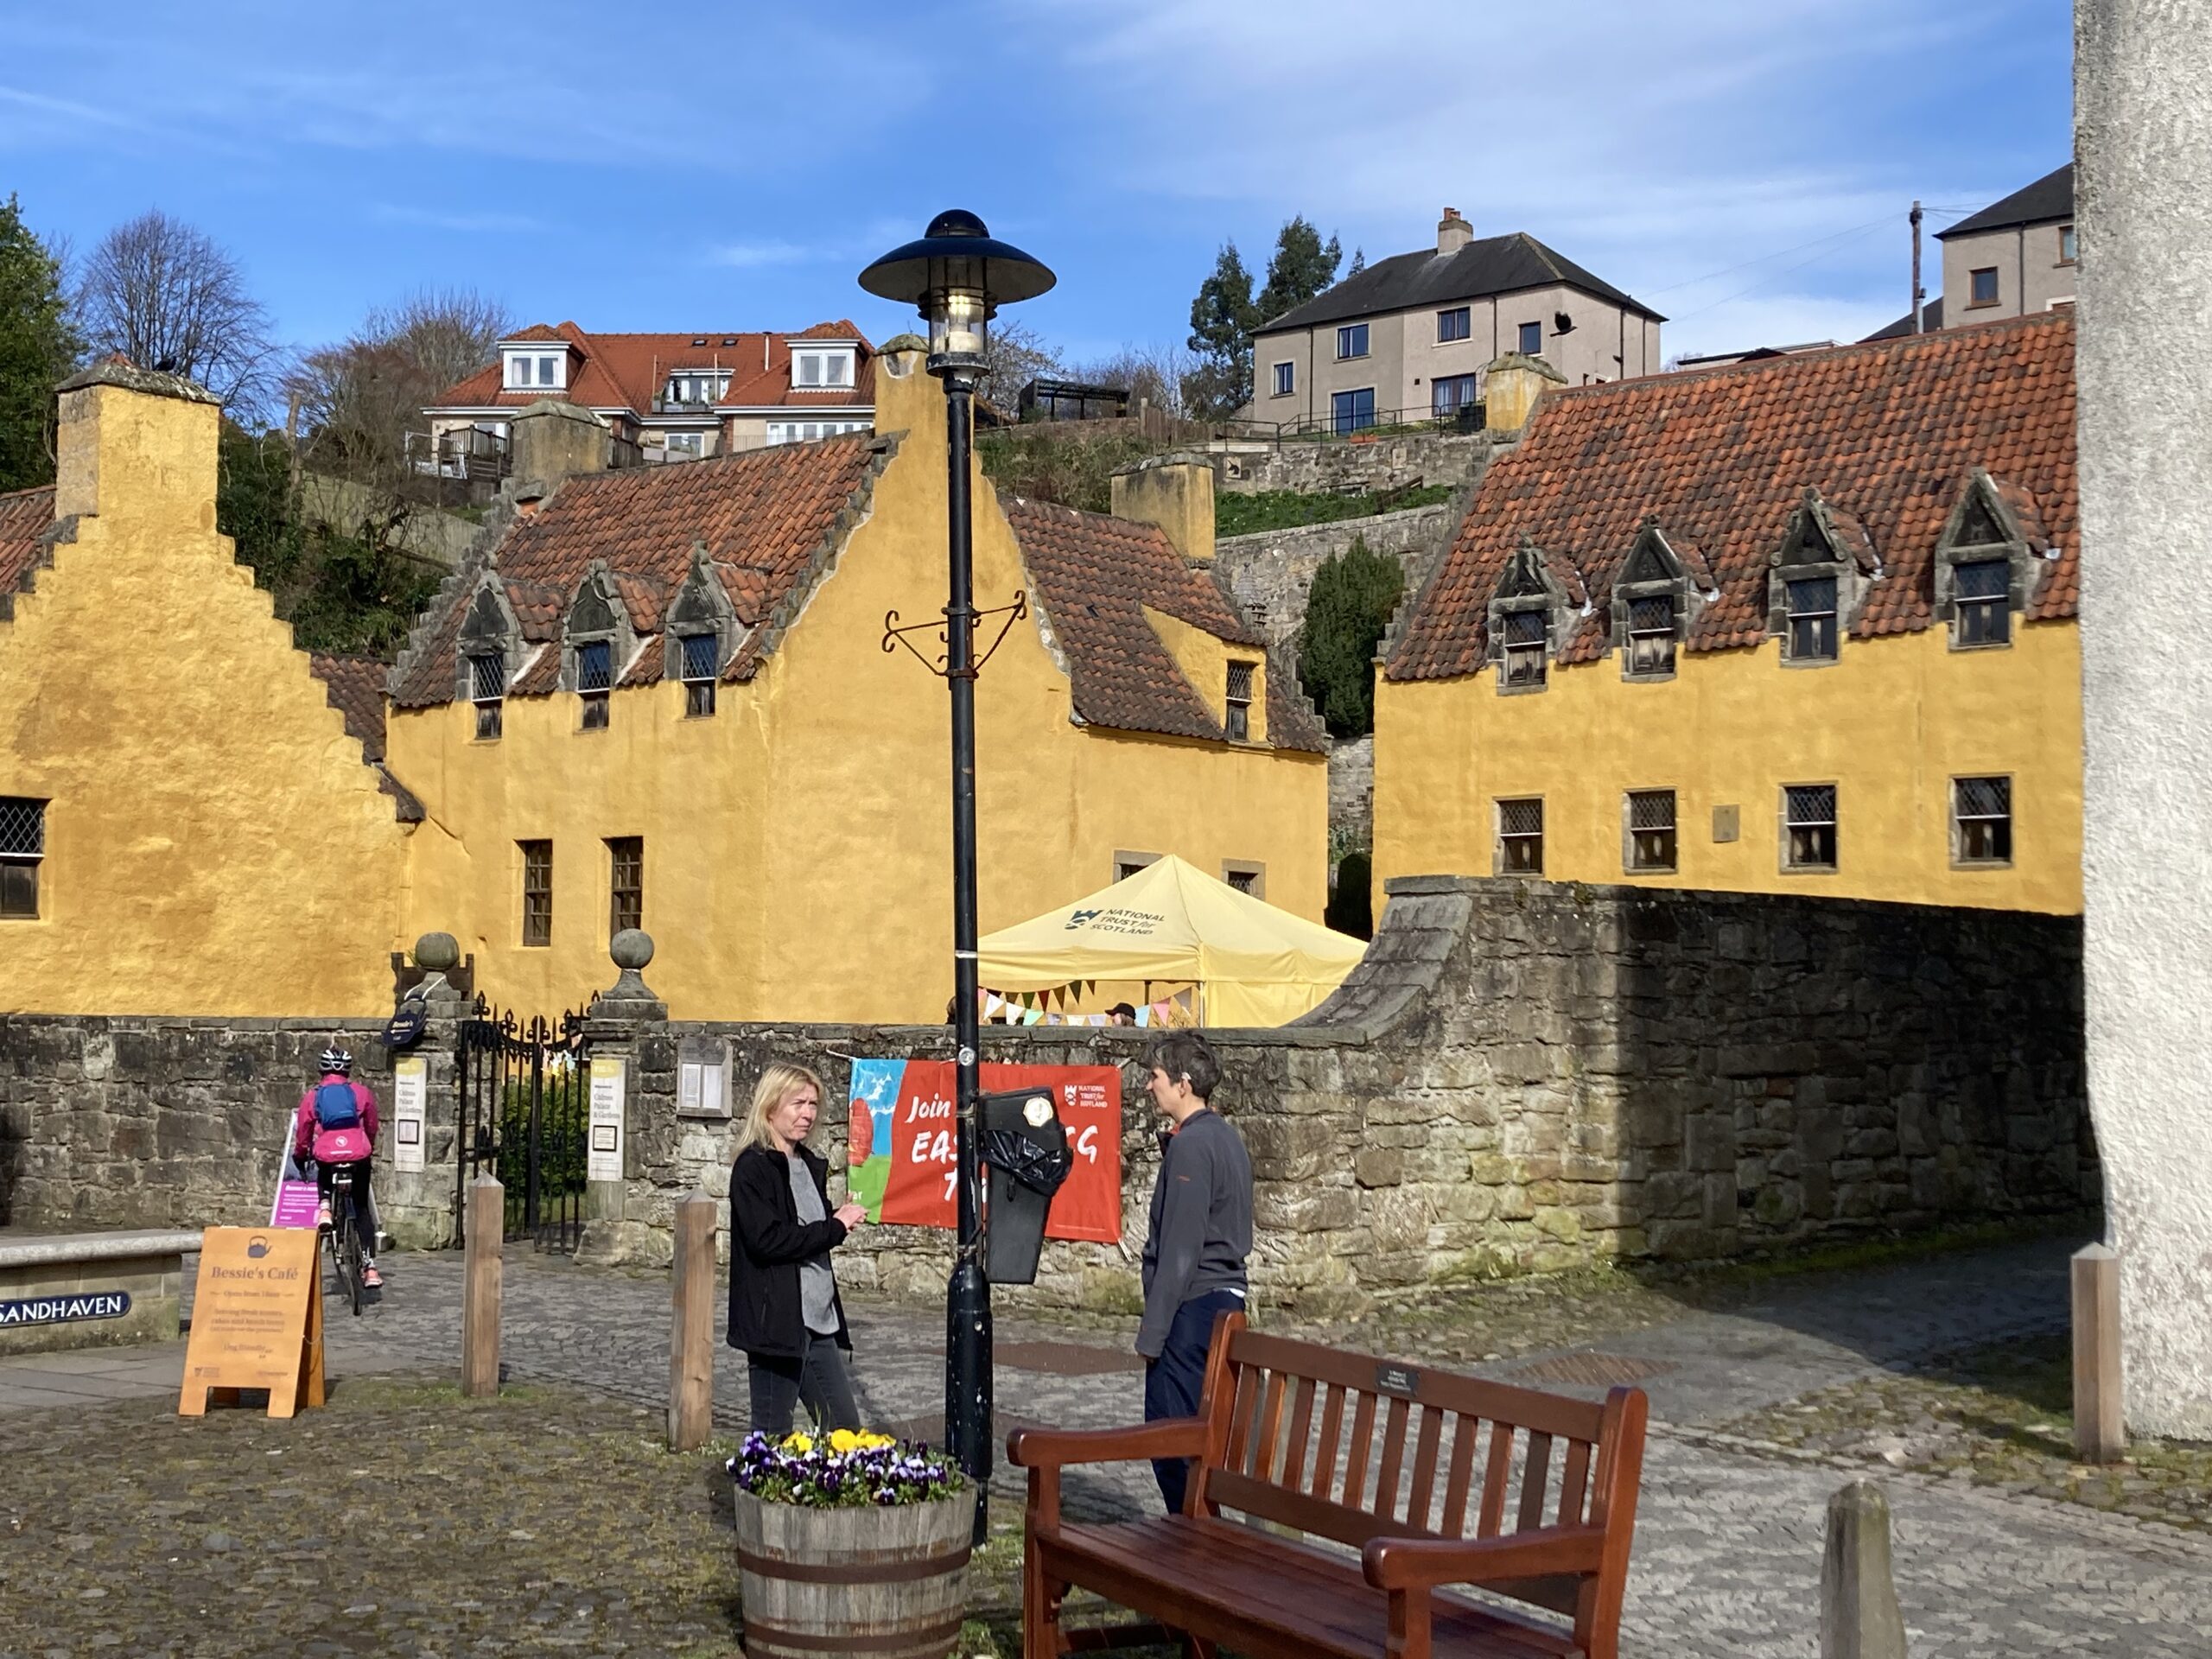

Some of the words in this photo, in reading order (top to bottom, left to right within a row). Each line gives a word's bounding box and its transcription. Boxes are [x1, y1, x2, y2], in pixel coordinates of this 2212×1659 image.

[1100, 916, 1139, 926] TRUST
[1106, 909, 1165, 921] NATIONAL
[1090, 924, 1154, 935] SCOTLAND
[905, 1093, 950, 1123] Join
[211, 1266, 264, 1280] Bessie's
[267, 1267, 299, 1281] Café
